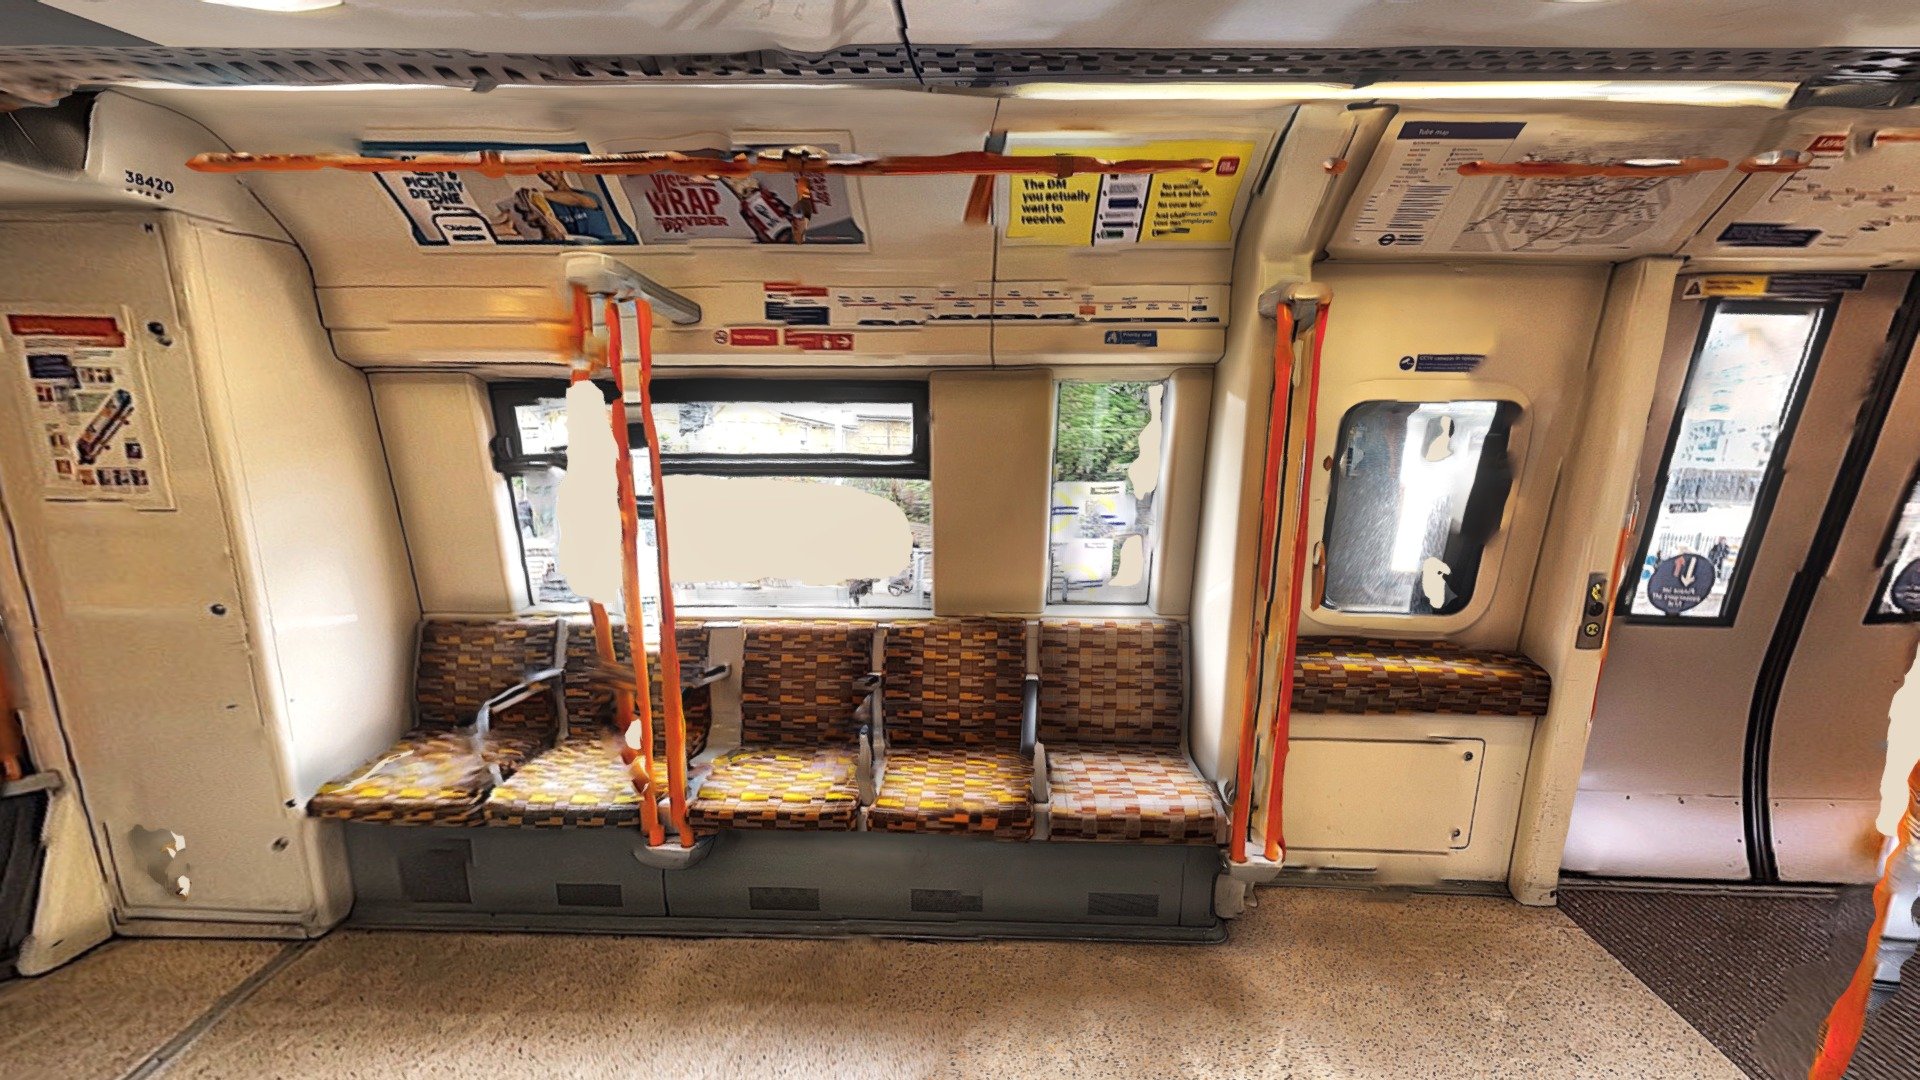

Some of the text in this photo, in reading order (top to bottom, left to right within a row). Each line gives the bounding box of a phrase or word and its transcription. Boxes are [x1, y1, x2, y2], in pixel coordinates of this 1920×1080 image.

[125, 169, 174, 194] 38420
[1022, 178, 1067, 190] The DM
[645, 188, 721, 216] WRAP
[1022, 189, 1091, 204] you actually
[1021, 203, 1064, 213] want to
